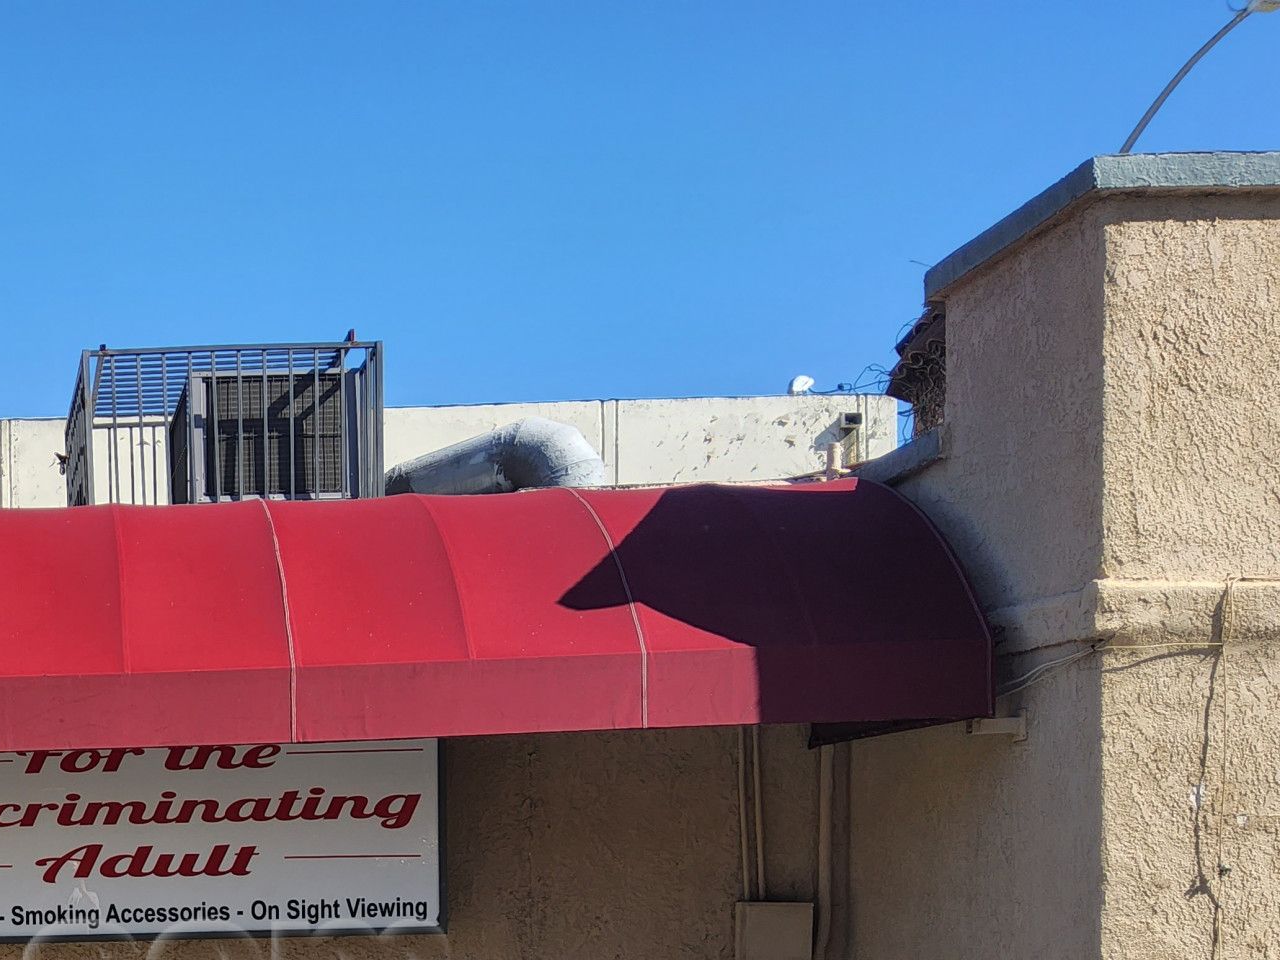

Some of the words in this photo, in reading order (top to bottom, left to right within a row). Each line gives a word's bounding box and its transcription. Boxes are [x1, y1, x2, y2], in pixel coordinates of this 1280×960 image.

[35, 844, 260, 884] Adult
[11, 904, 100, 929] Smoking
[105, 902, 230, 924] Accessories
[251, 900, 280, 921] On
[287, 898, 340, 925] Sight
[346, 897, 428, 921] Viewing
